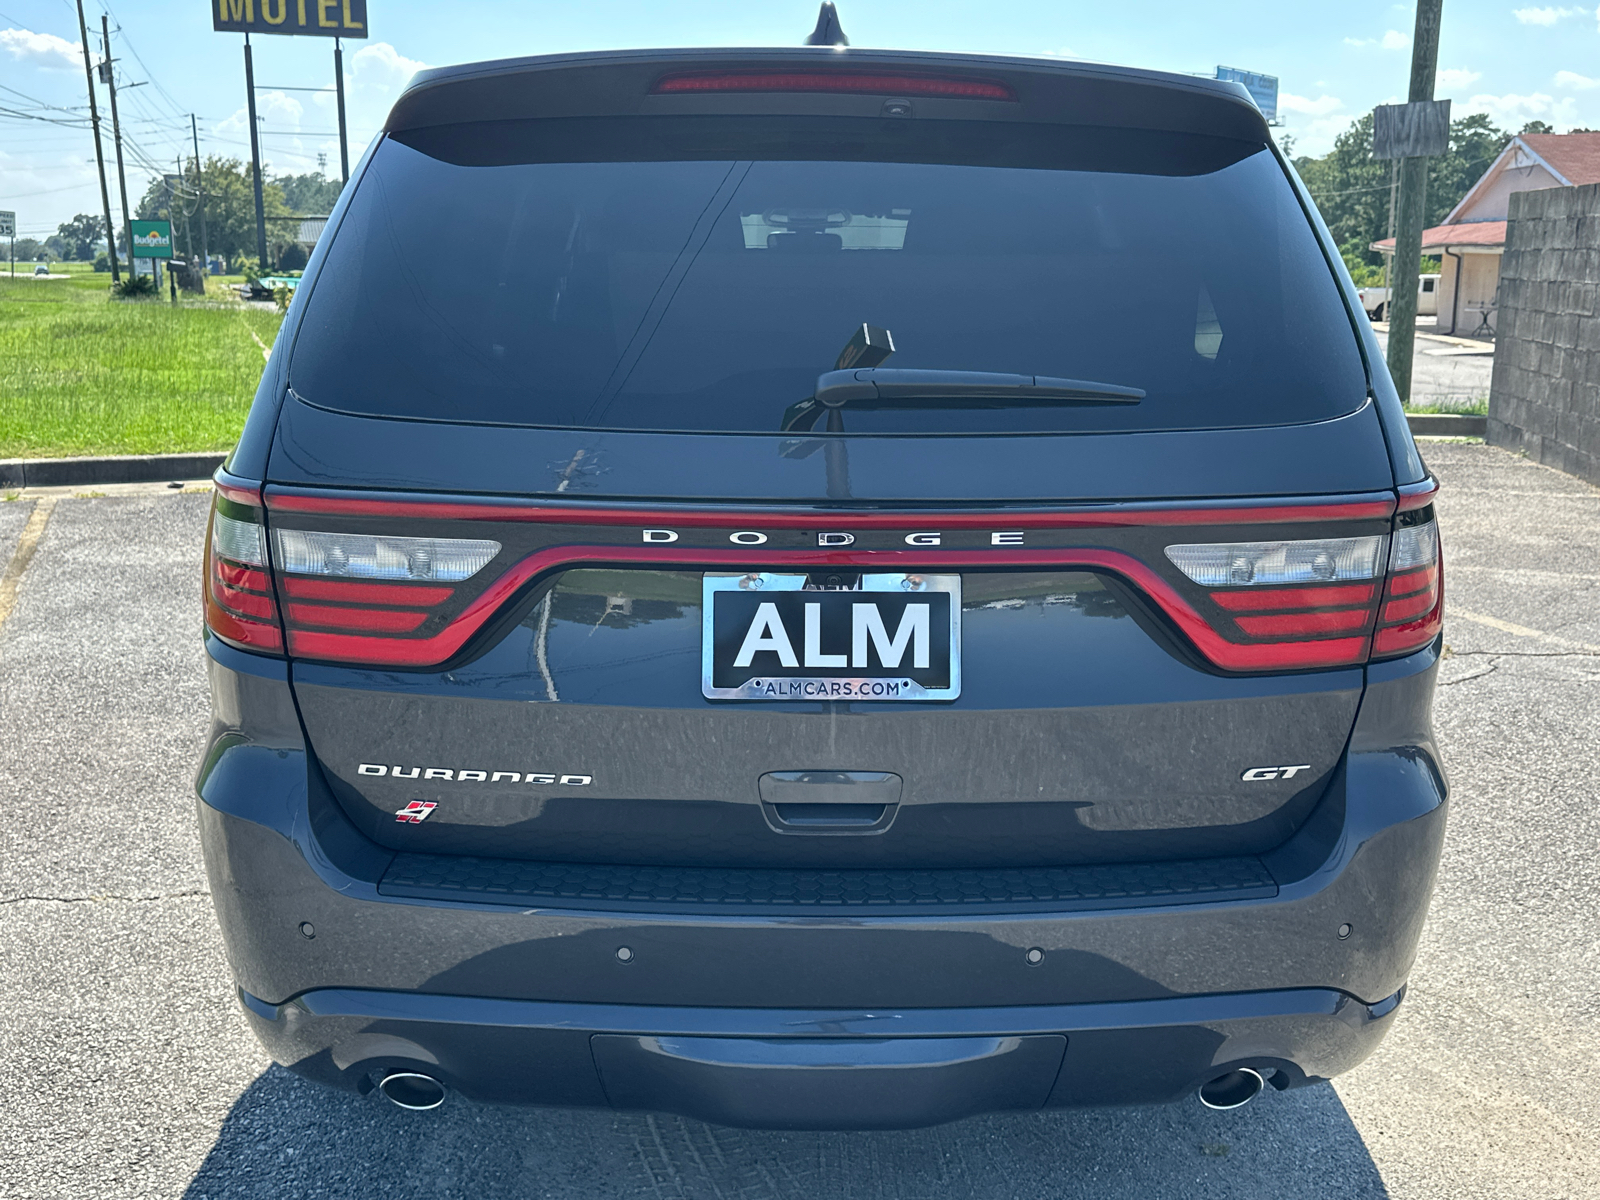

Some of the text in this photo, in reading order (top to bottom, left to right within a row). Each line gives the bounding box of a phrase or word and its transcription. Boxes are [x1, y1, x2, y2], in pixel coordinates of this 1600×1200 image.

[133, 234, 169, 247] Budgetel
[642, 528, 1024, 547] DODGE
[732, 602, 931, 669] ALM
[763, 681, 900, 697] ALMCARS.COM
[357, 763, 593, 786] DURANGO
[1242, 764, 1311, 781] GT
